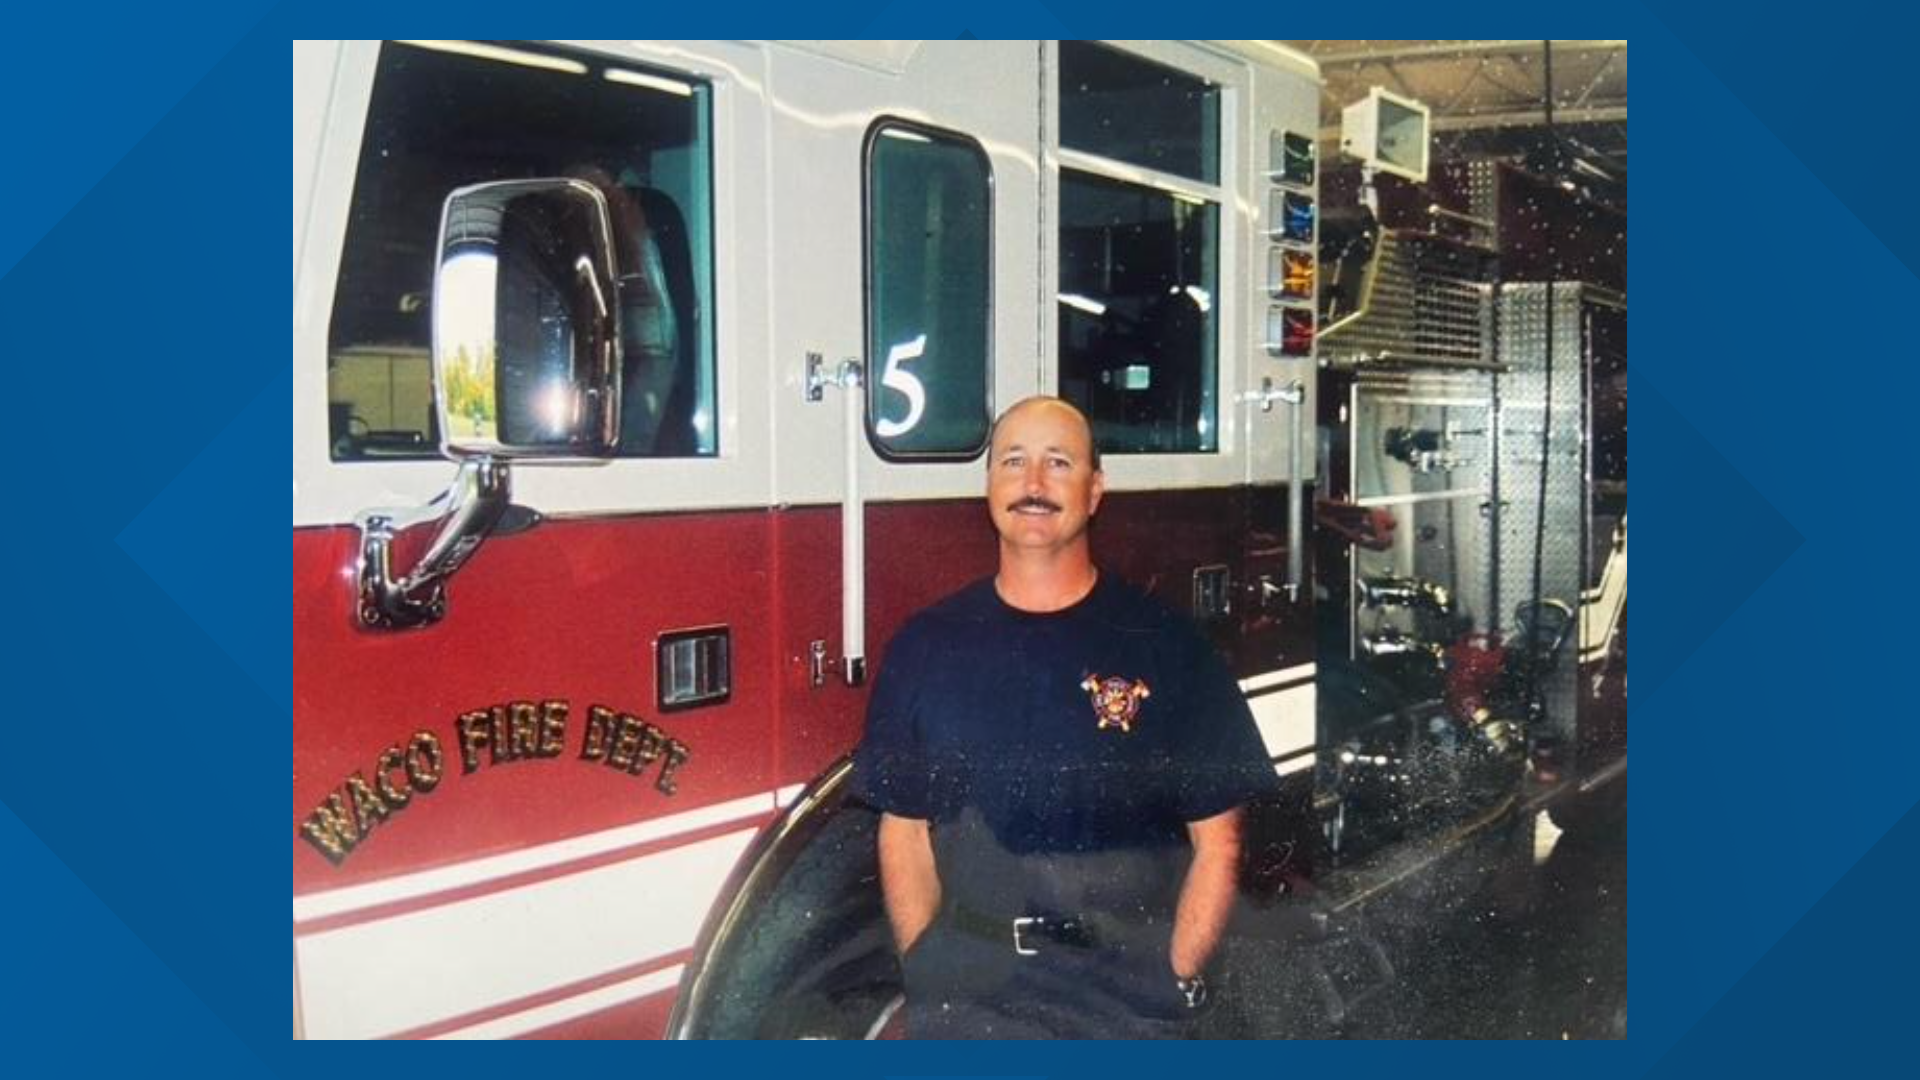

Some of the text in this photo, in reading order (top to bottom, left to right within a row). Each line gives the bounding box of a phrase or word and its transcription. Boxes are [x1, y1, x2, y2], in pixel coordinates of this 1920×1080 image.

[876, 333, 927, 437] 5
[300, 728, 443, 864] WACO
[455, 700, 569, 774] FIRE
